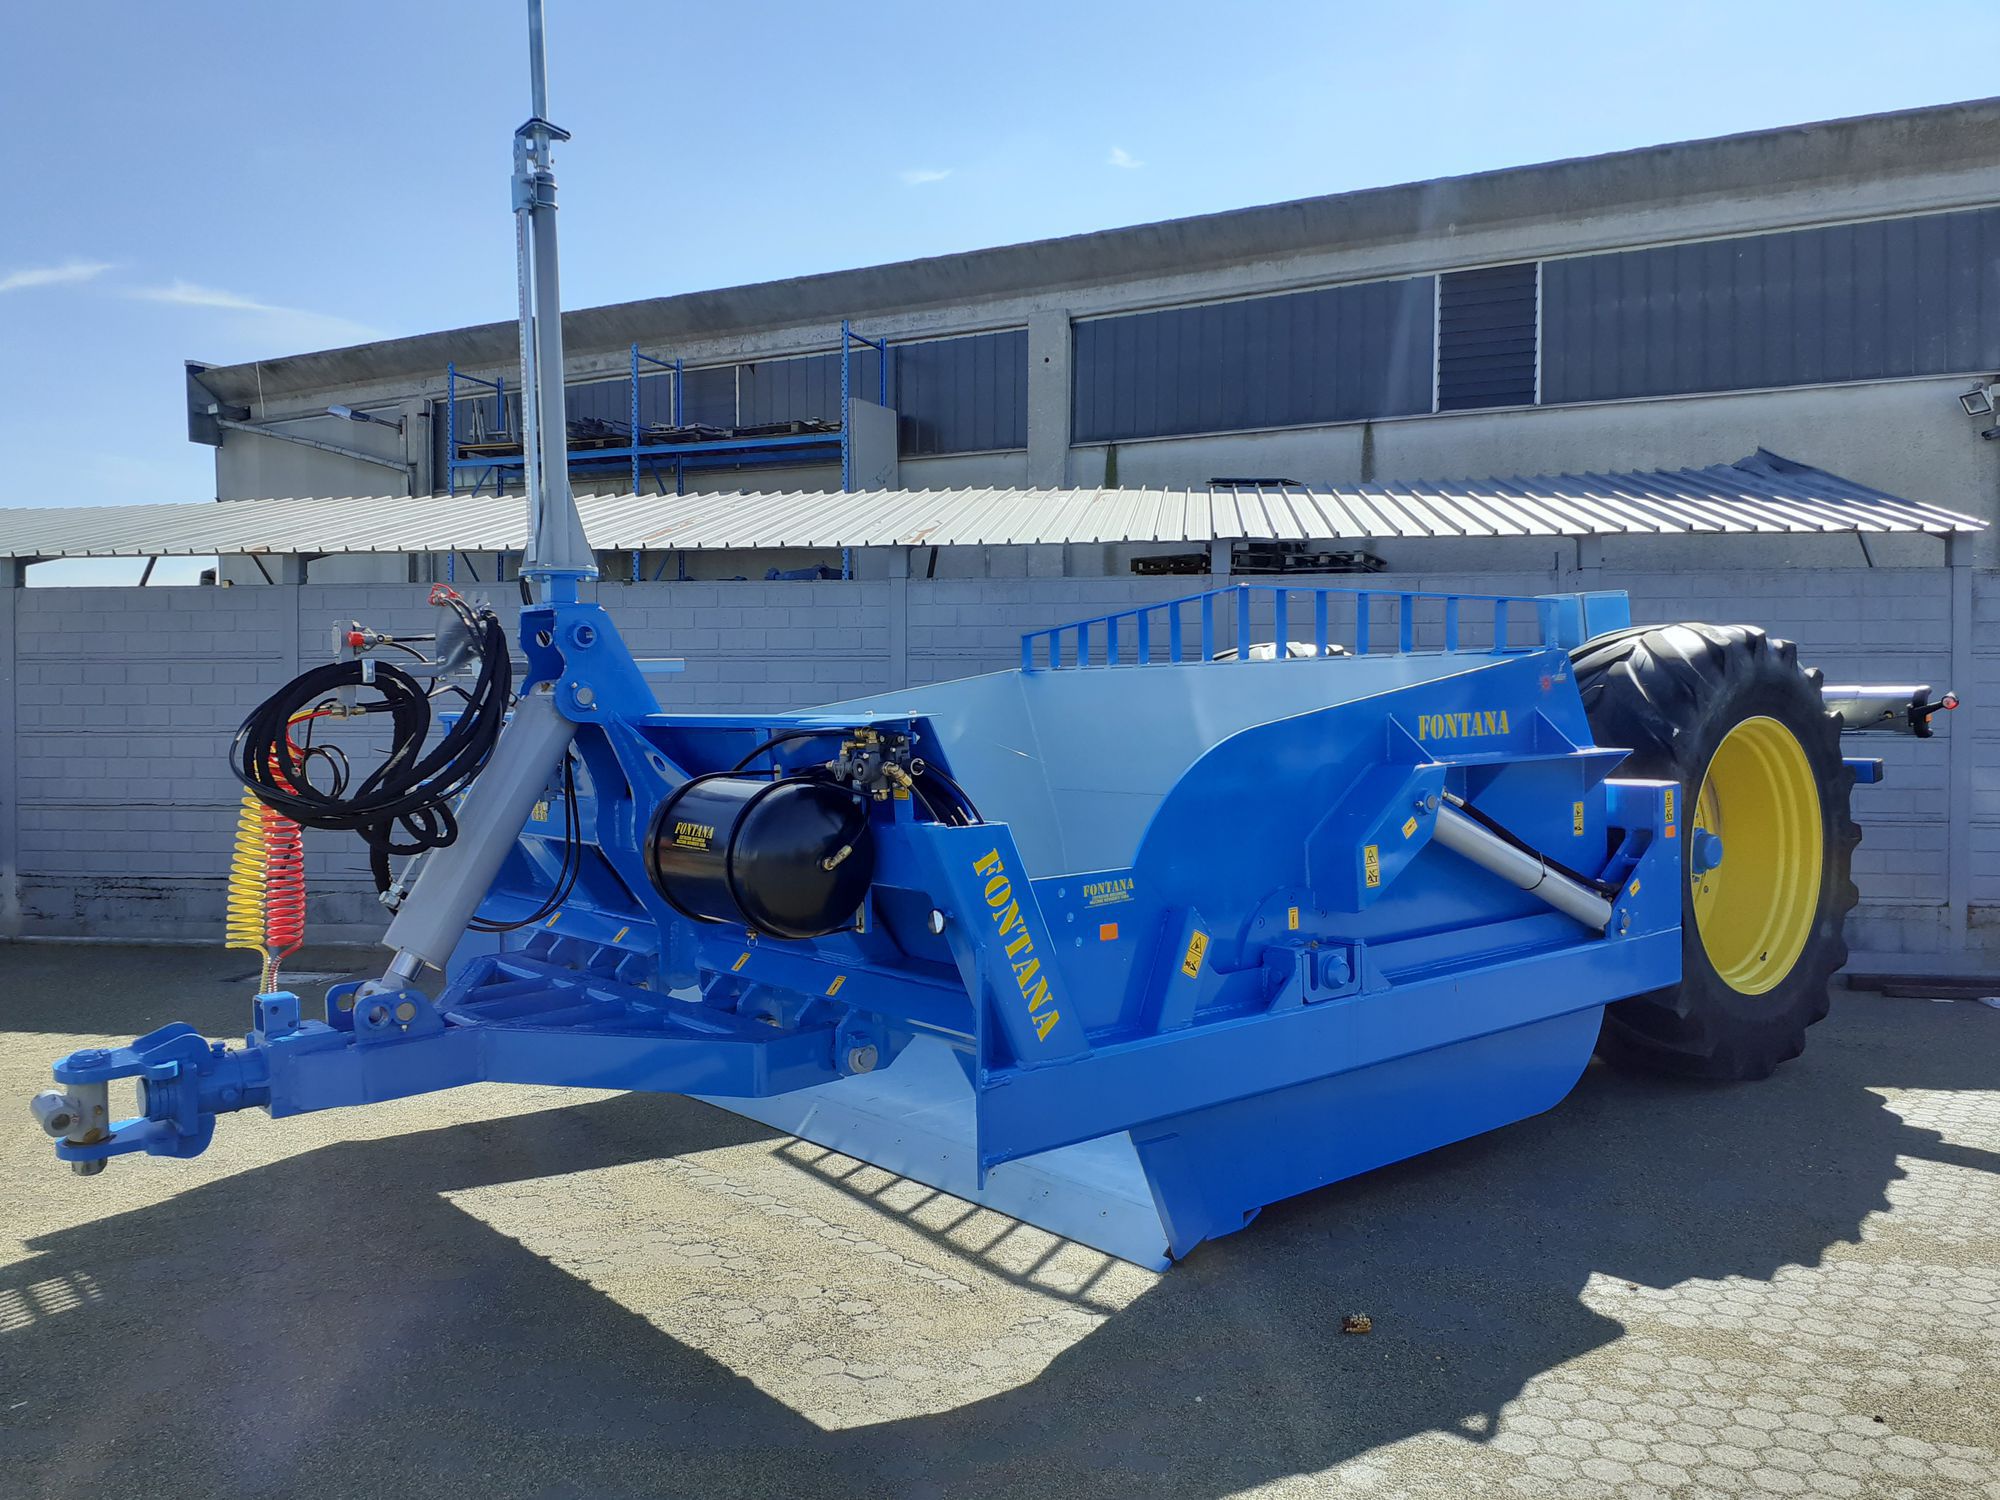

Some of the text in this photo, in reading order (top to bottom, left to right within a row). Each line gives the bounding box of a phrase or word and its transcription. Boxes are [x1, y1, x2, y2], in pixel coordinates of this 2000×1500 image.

[1418, 710, 1510, 741] FONTANA
[674, 821, 715, 839] FONTANA
[1082, 877, 1135, 898] FONTANA
[972, 847, 1060, 1043] FONTANA
